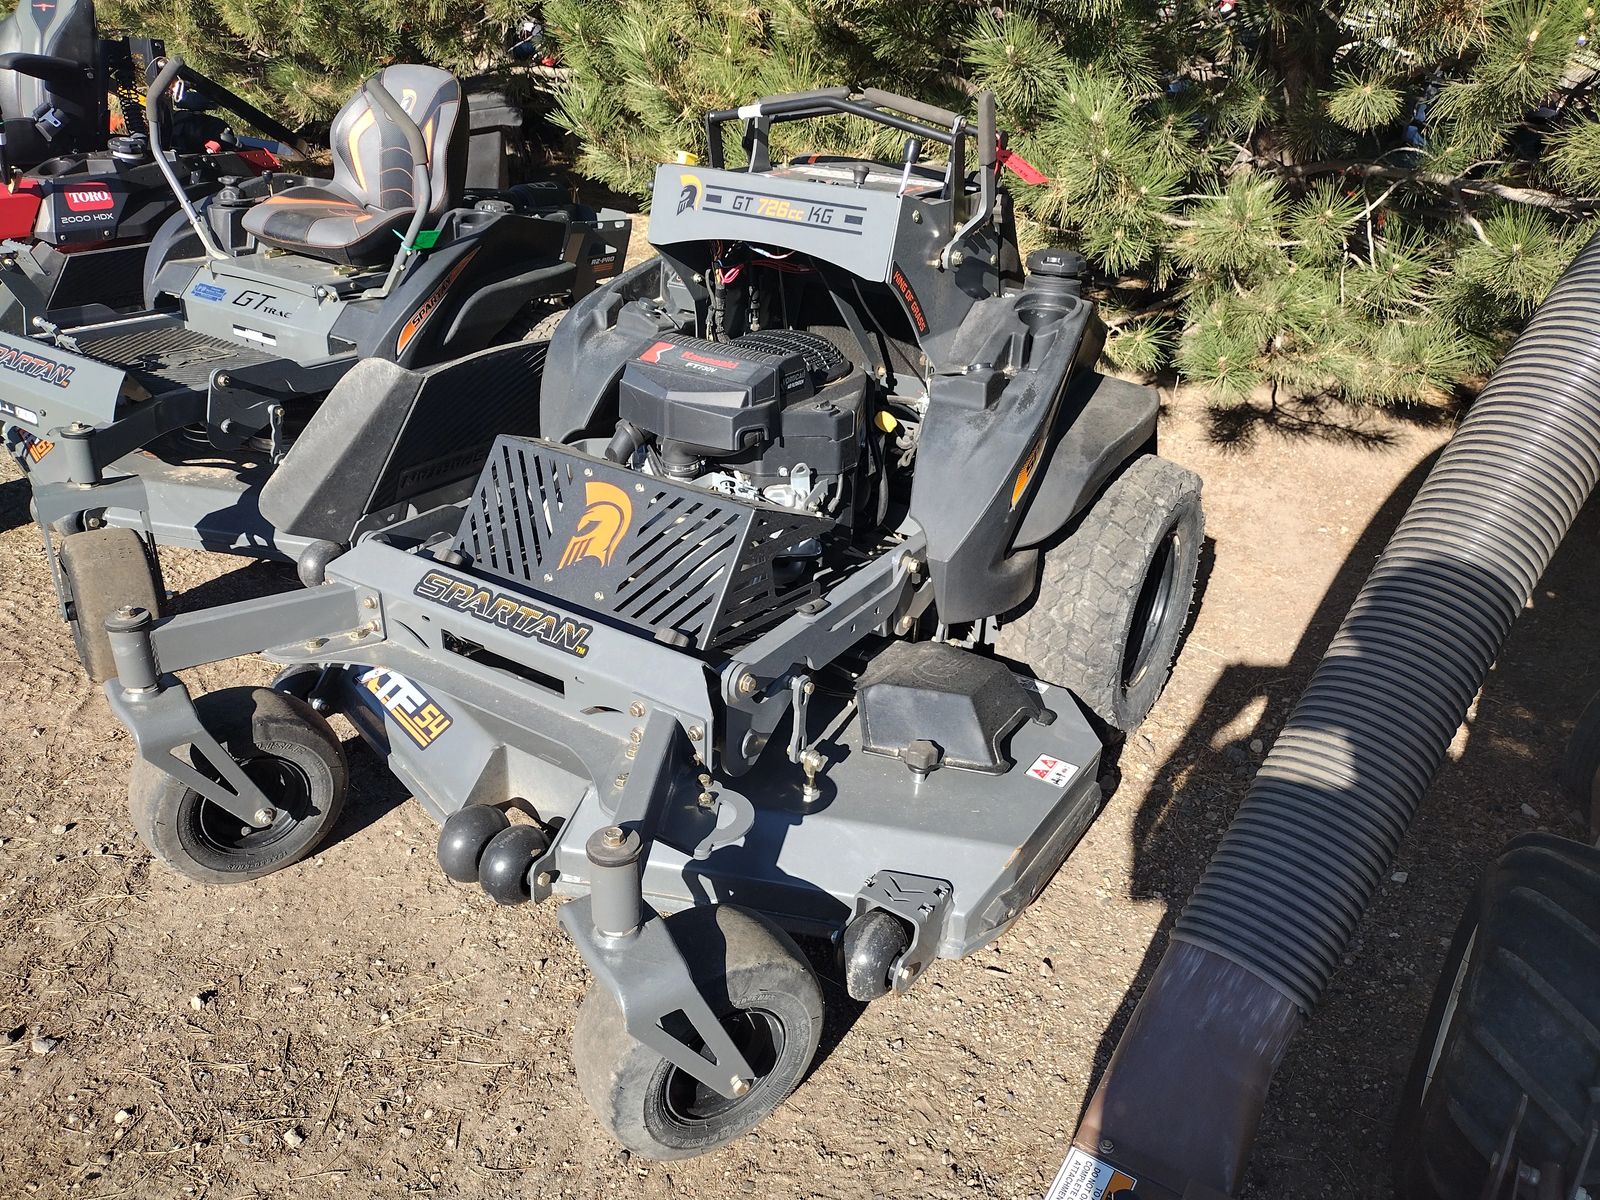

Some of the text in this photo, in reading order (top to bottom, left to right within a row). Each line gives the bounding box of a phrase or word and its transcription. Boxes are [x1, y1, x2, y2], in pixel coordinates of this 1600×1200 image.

[68, 191, 108, 203] TORO
[732, 195, 834, 225] GT 726cc KG
[61, 213, 114, 224] 2000 HDX
[591, 256, 615, 265] RZ-PRO
[232, 290, 277, 309] GT
[893, 271, 926, 332] KING OF GRASS
[416, 573, 589, 651] SPARTAN
[413, 703, 451, 739] 54
[1070, 1160, 1093, 1197] COMPLETE
[1085, 1166, 1101, 1193] DO NOT
